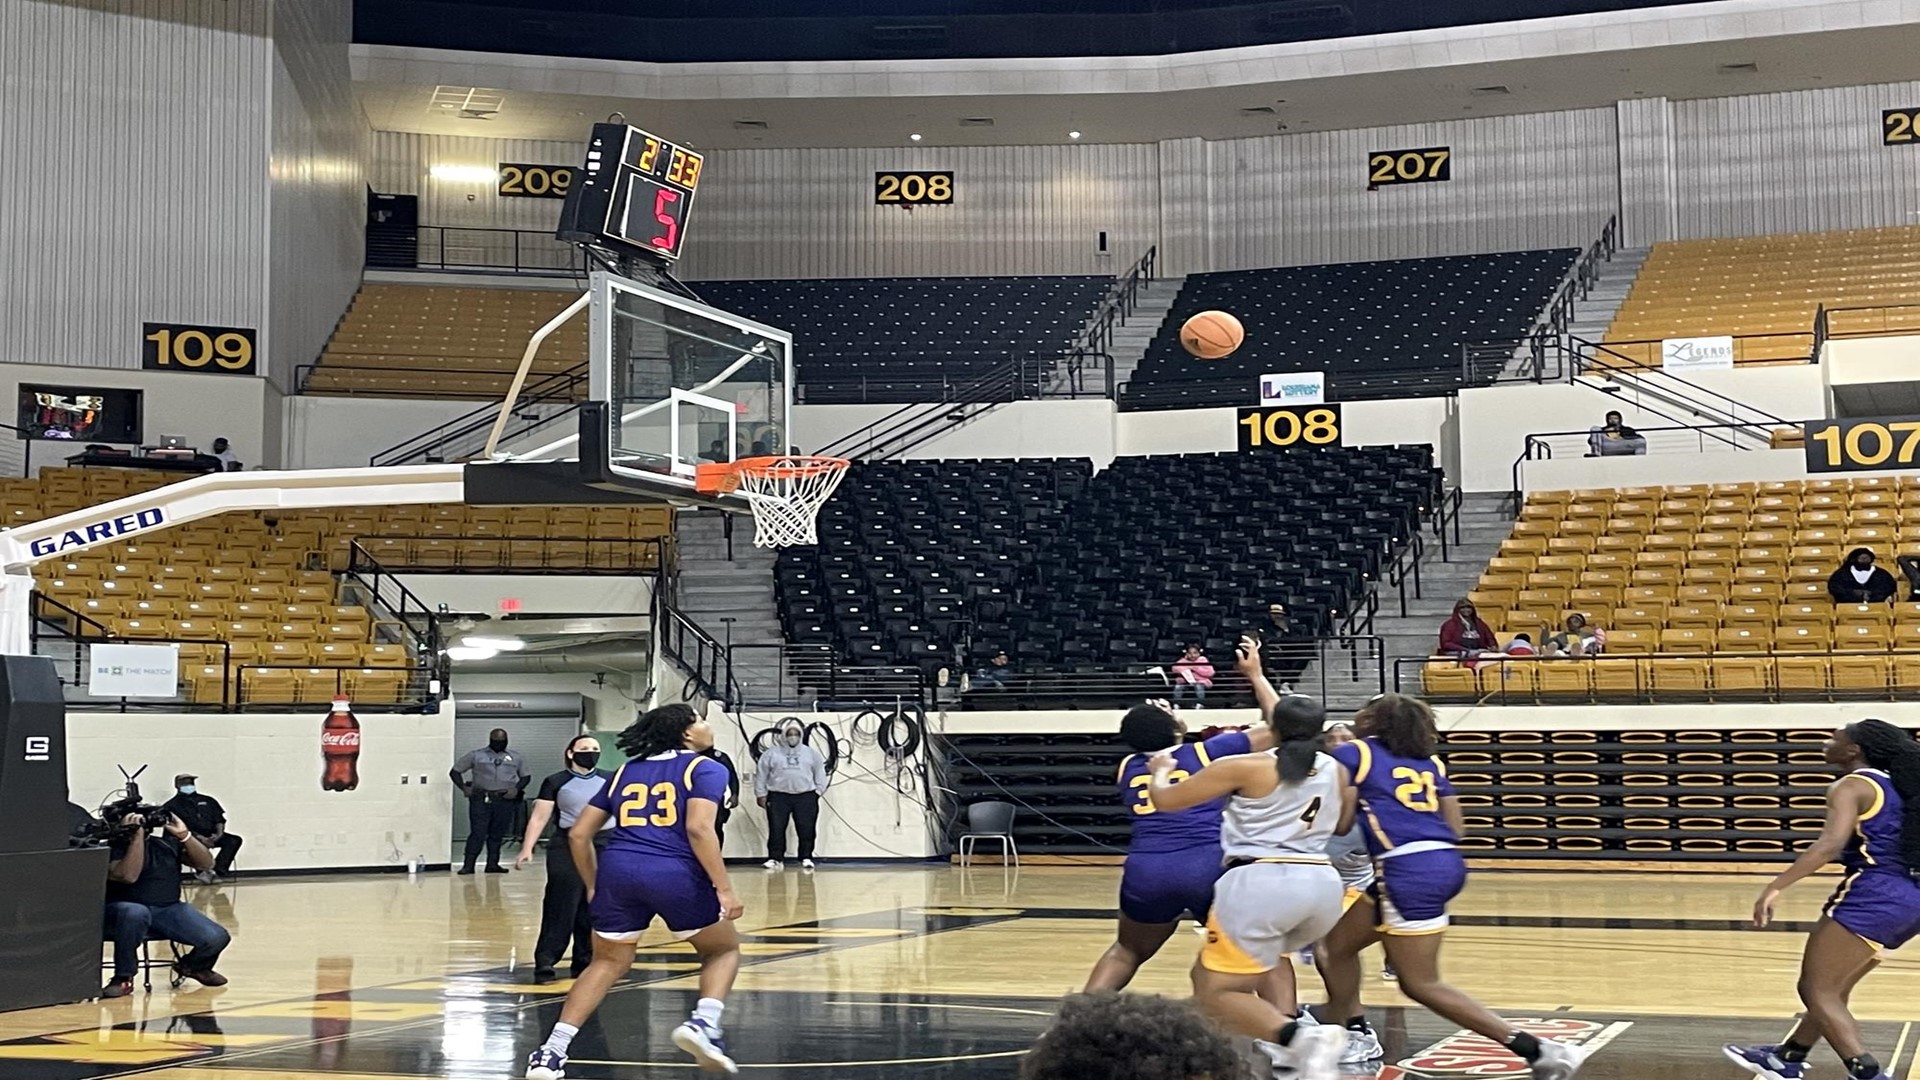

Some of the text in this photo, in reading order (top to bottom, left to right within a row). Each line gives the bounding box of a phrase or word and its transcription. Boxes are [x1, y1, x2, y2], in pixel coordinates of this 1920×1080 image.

[501, 166, 571, 194] 209
[1370, 151, 1449, 181] 207
[878, 174, 952, 201] 208
[652, 188, 678, 250] 5
[146, 329, 252, 369] 109
[1240, 409, 1338, 446] 108
[1813, 422, 1920, 466] 107
[30, 507, 164, 557] GARED
[620, 782, 678, 828] 23
[1392, 766, 1439, 812] 21
[1300, 796, 1322, 831] 4
